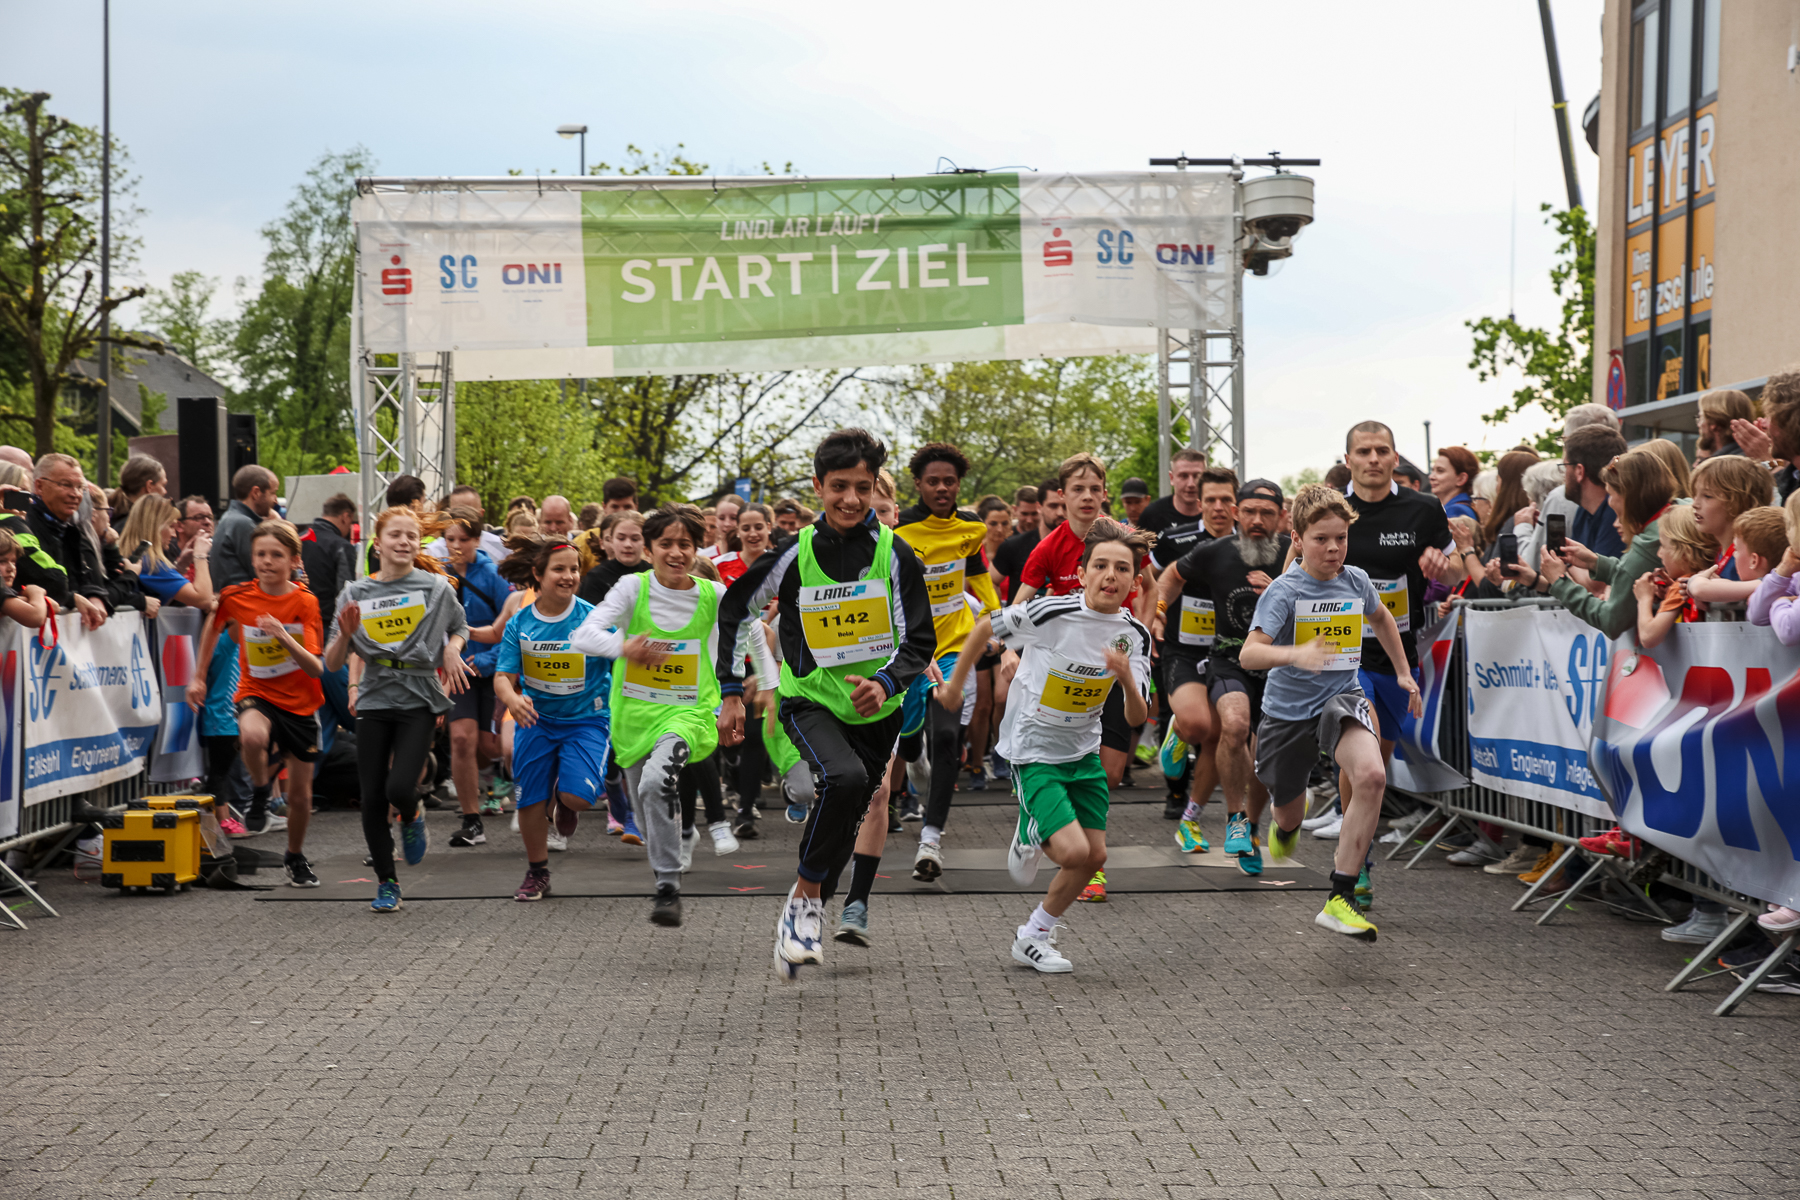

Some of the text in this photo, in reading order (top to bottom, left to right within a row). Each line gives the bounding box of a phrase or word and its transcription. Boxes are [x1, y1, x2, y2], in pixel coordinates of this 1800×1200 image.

[1627, 113, 1716, 224] LEYER
[720, 211, 884, 241] LINDLAR LÄUFT
[1156, 243, 1215, 266] ONI
[502, 263, 562, 285] ONI
[620, 252, 814, 304] START
[856, 242, 989, 291] ZIEL
[926, 580, 955, 592] 1166
[814, 586, 852, 601] LANG
[372, 598, 399, 610] LANG
[1312, 602, 1341, 613] LANG
[375, 616, 412, 629] 1201
[819, 612, 869, 628] 1142
[1313, 626, 1352, 636] 1256
[533, 643, 561, 651] LANG
[876, 643, 893, 651] ONI
[535, 661, 571, 670] 1208
[1066, 662, 1102, 677] LANG
[1062, 685, 1102, 698] 1232
